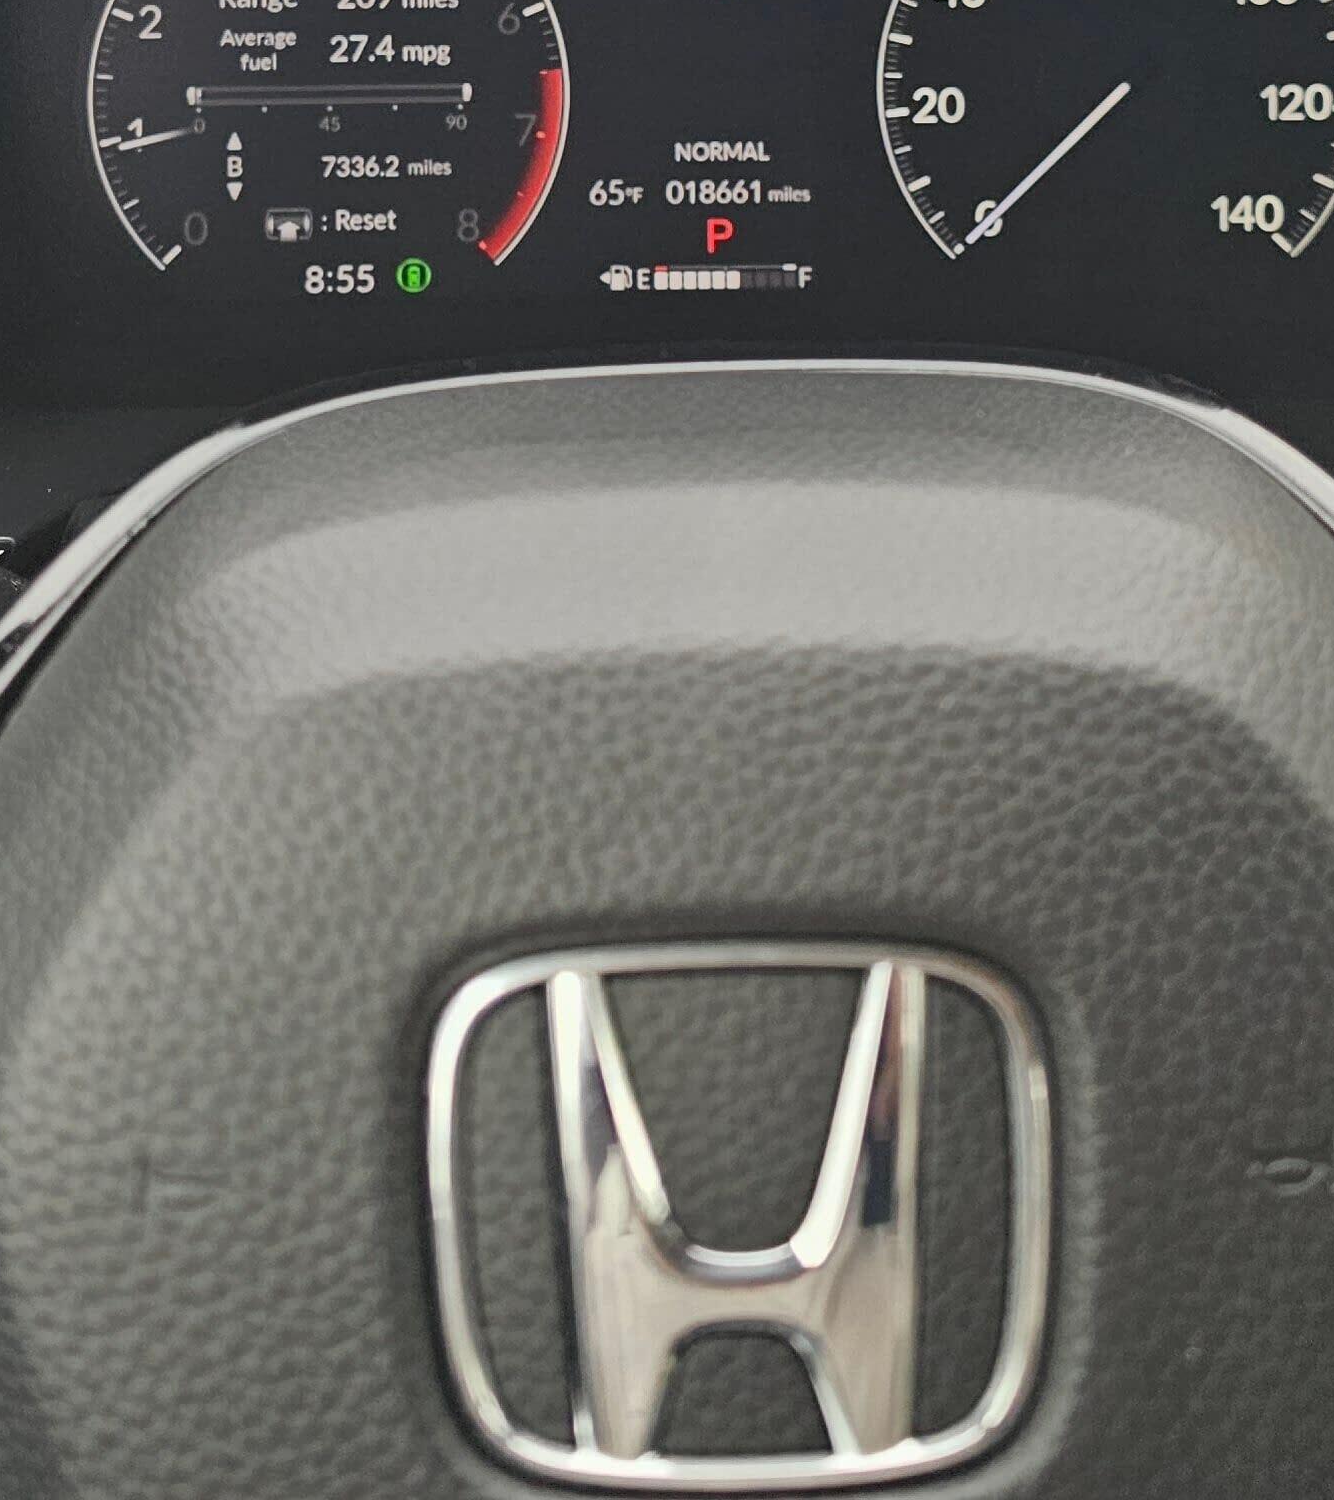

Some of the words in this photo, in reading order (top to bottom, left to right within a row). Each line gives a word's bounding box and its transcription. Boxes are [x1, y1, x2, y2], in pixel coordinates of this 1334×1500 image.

[138, 4, 163, 41] 2
[497, 0, 521, 36] 6
[219, 28, 298, 49] Average
[328, 33, 396, 64] 27.4
[401, 42, 452, 66] mpg
[239, 51, 278, 72] fuel
[911, 85, 966, 125] 20
[1260, 83, 1334, 122] 120
[192, 115, 207, 134] 0
[318, 114, 342, 133] 45
[445, 113, 467, 133] 90
[514, 112, 536, 148] 7
[674, 141, 771, 163] NORMAL
[226, 156, 244, 179] B
[320, 155, 401, 180] 7336.2
[407, 157, 453, 178] miles
[665, 179, 763, 206] 018661
[767, 184, 812, 204] miles
[334, 209, 398, 233] Reset
[457, 209, 481, 245] 8
[1212, 194, 1285, 233] 140
[182, 211, 209, 247] 0
[705, 216, 735, 254] P
[304, 265, 376, 295] 8:55
[636, 267, 652, 291] E
[798, 266, 814, 289] F
